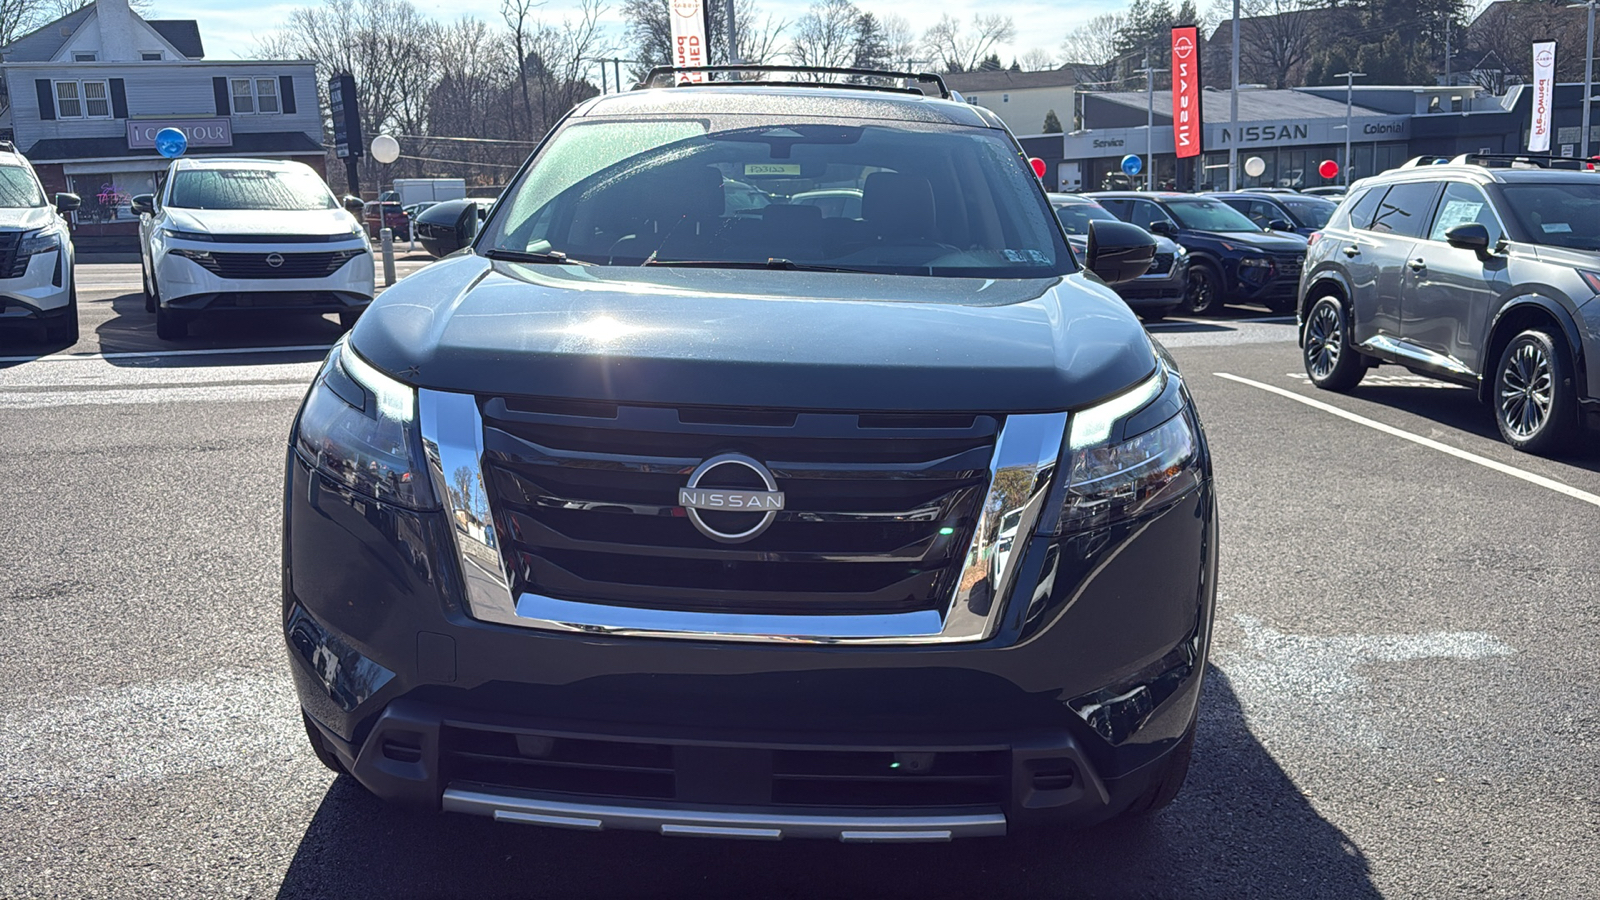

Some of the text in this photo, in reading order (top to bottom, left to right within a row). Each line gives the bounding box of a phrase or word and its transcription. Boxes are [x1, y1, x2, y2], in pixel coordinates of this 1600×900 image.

[145, 126, 224, 141] CTOUR
[1222, 124, 1308, 143] NISSAN
[1363, 121, 1404, 135] Colonial
[1093, 138, 1124, 148] Service
[682, 491, 781, 508] NISSAN
